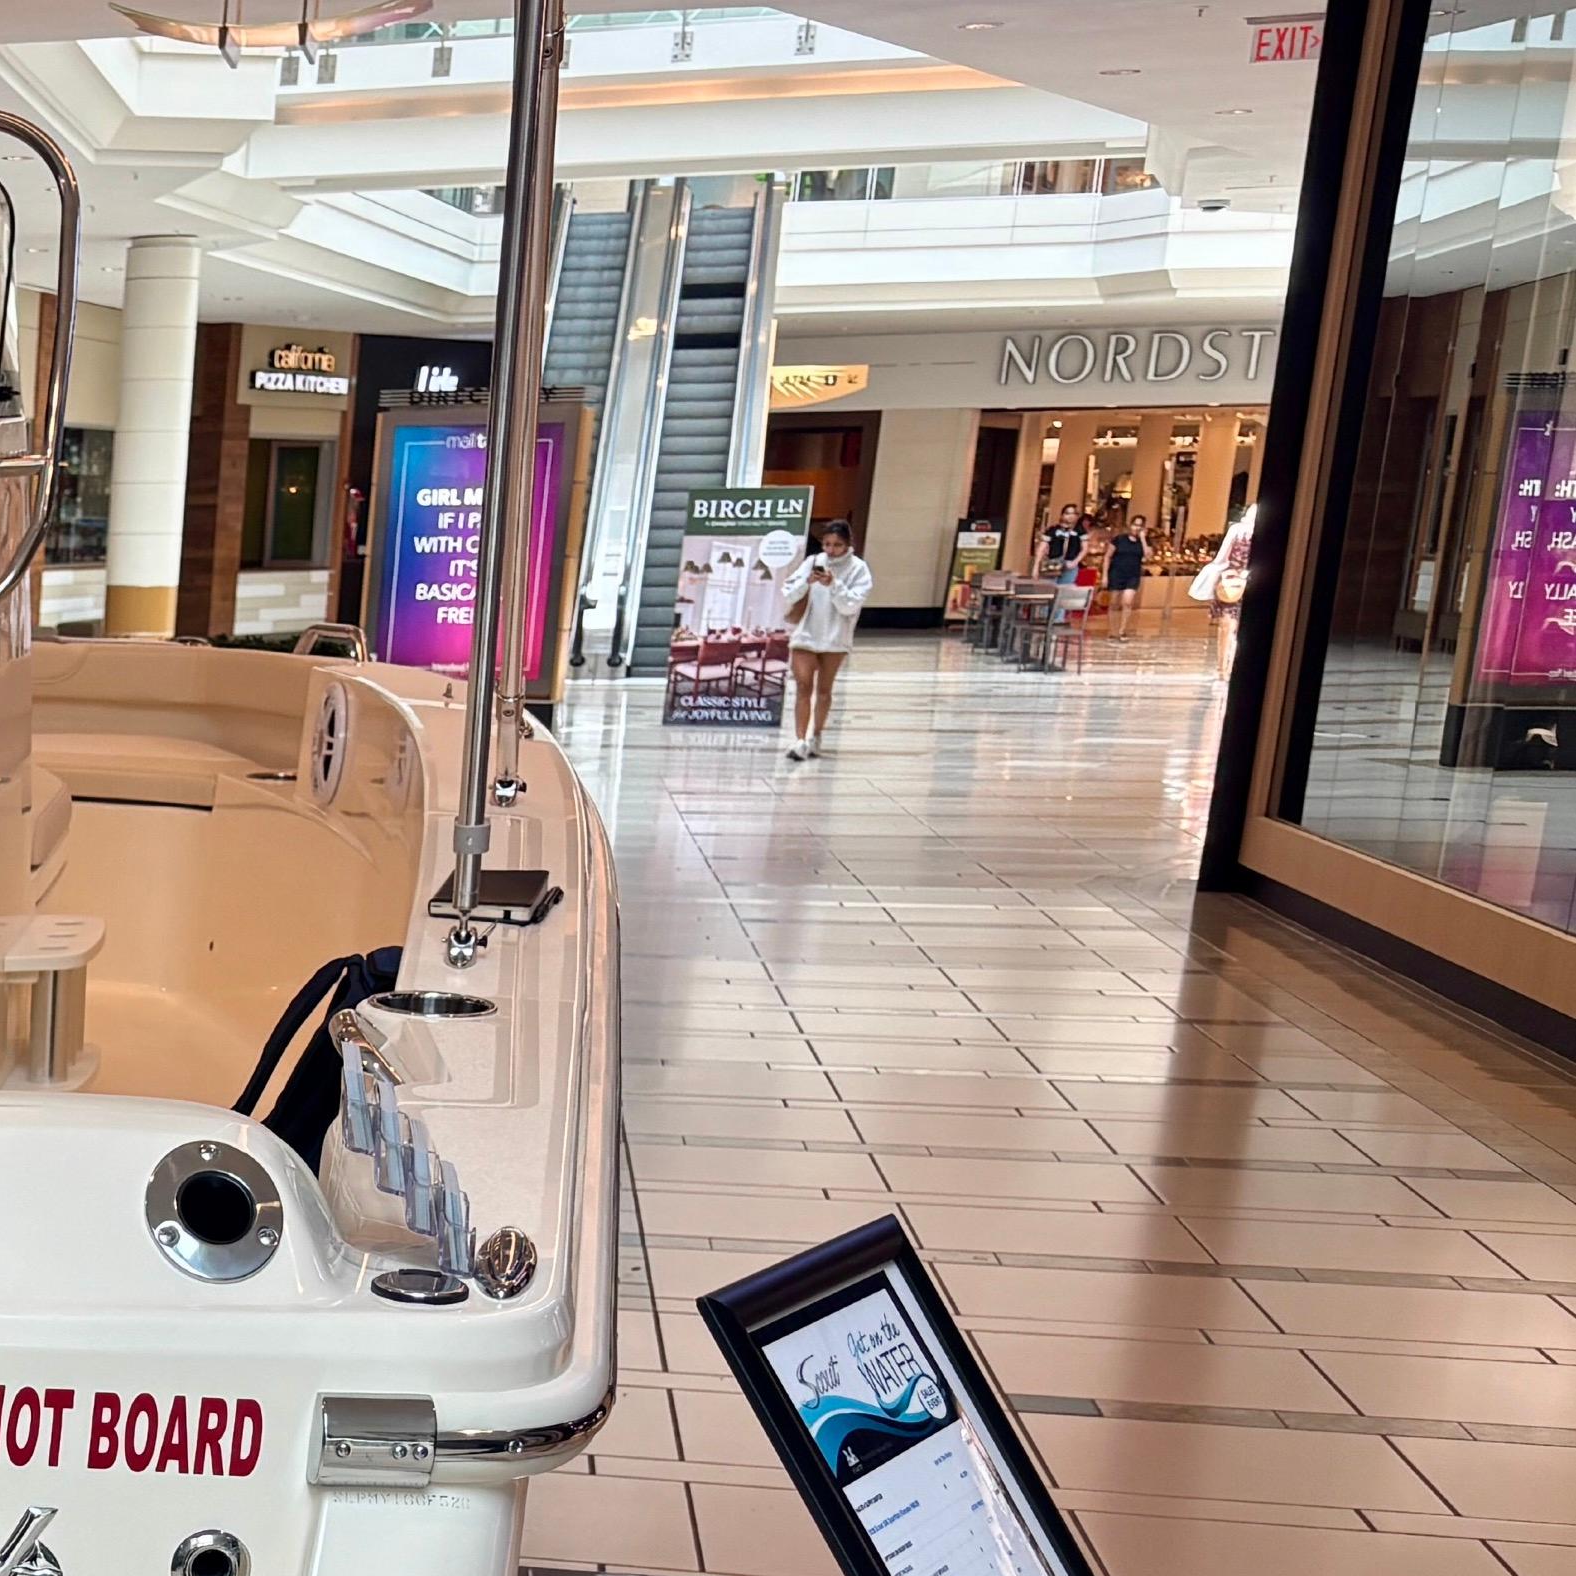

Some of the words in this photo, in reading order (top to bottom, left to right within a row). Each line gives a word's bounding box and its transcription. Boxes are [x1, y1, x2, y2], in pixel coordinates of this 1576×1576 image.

[1255, 26, 1313, 62] EXIT
[254, 370, 295, 392] PIZZA
[296, 373, 349, 395] KITCHEN
[416, 488, 462, 507] GIRL
[693, 499, 772, 519] BIRCH
[775, 498, 804, 515] LN
[438, 512, 456, 530] IF
[413, 536, 463, 554] WITH
[449, 559, 479, 577] IT'S
[680, 695, 731, 708] CLASSIC
[732, 696, 768, 709] STYLE
[688, 710, 730, 721] JOYFUL
[733, 710, 773, 721] LIVING
[847, 1331, 872, 1360] Get
[869, 1331, 883, 1349] on
[881, 1313, 901, 1342] the
[857, 1342, 925, 1396] WATER
[797, 1354, 840, 1410] Scout
[87, 1391, 264, 1477] BOARD
